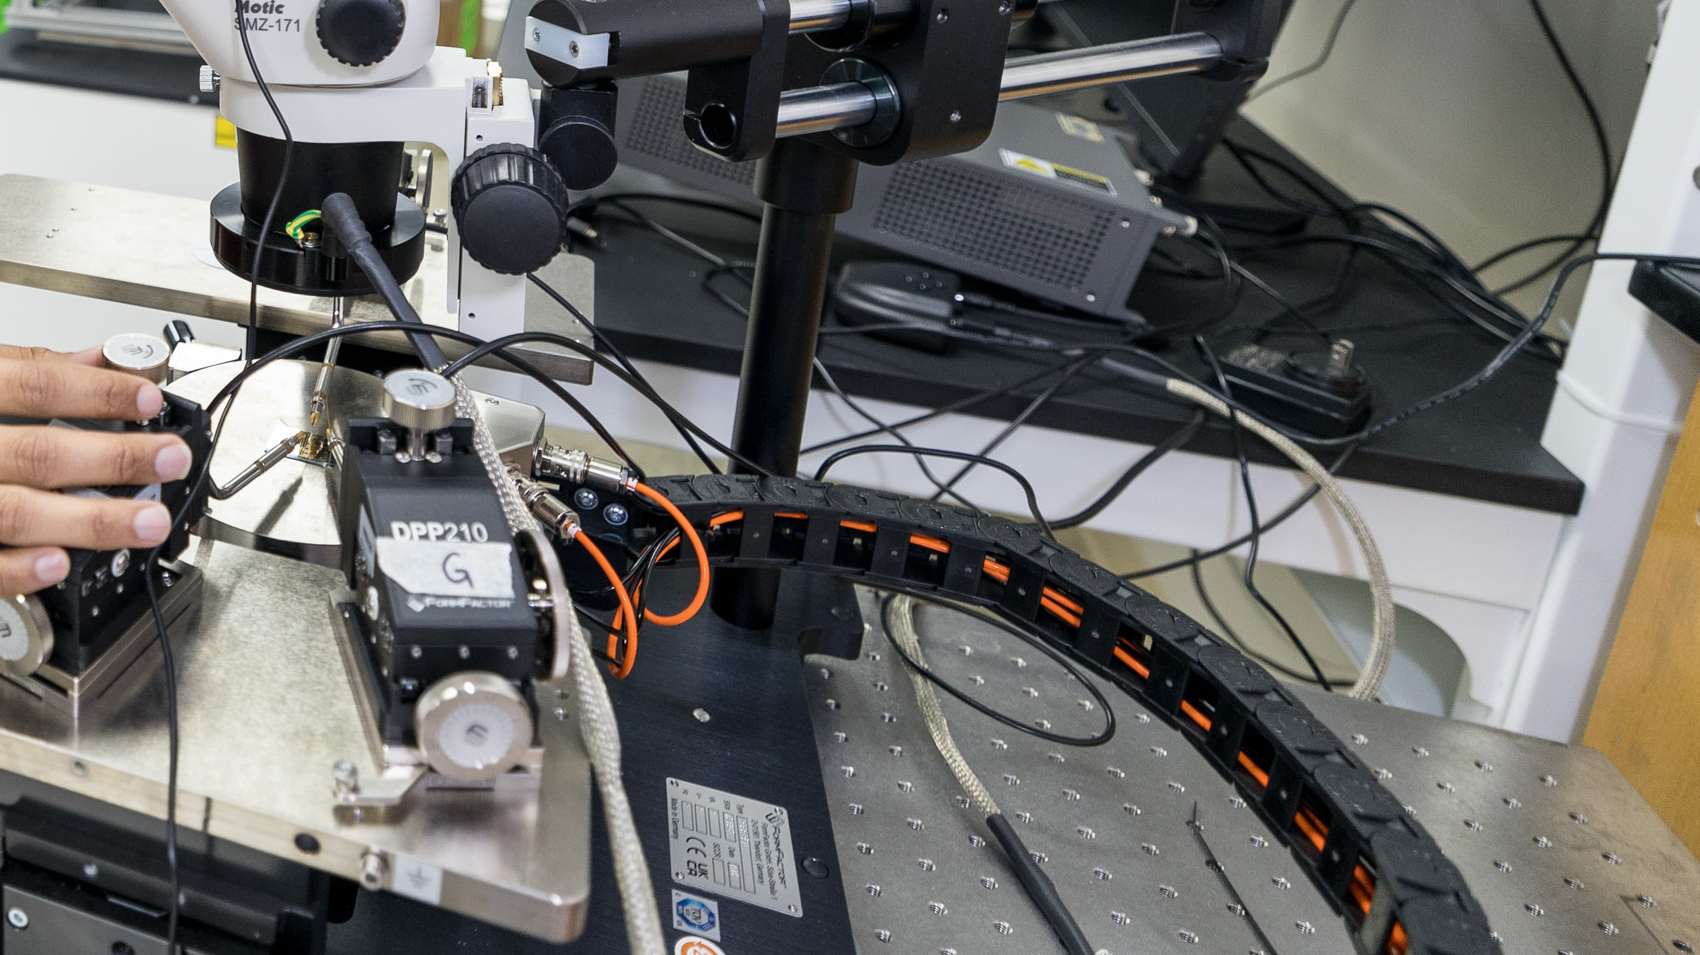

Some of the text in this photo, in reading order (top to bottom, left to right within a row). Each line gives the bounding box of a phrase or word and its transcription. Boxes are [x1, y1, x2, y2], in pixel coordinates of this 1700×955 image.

[234, 0, 285, 14] Motic
[234, 17, 300, 32] SMZ-171
[390, 521, 488, 543] DPP210
[442, 552, 474, 589] G
